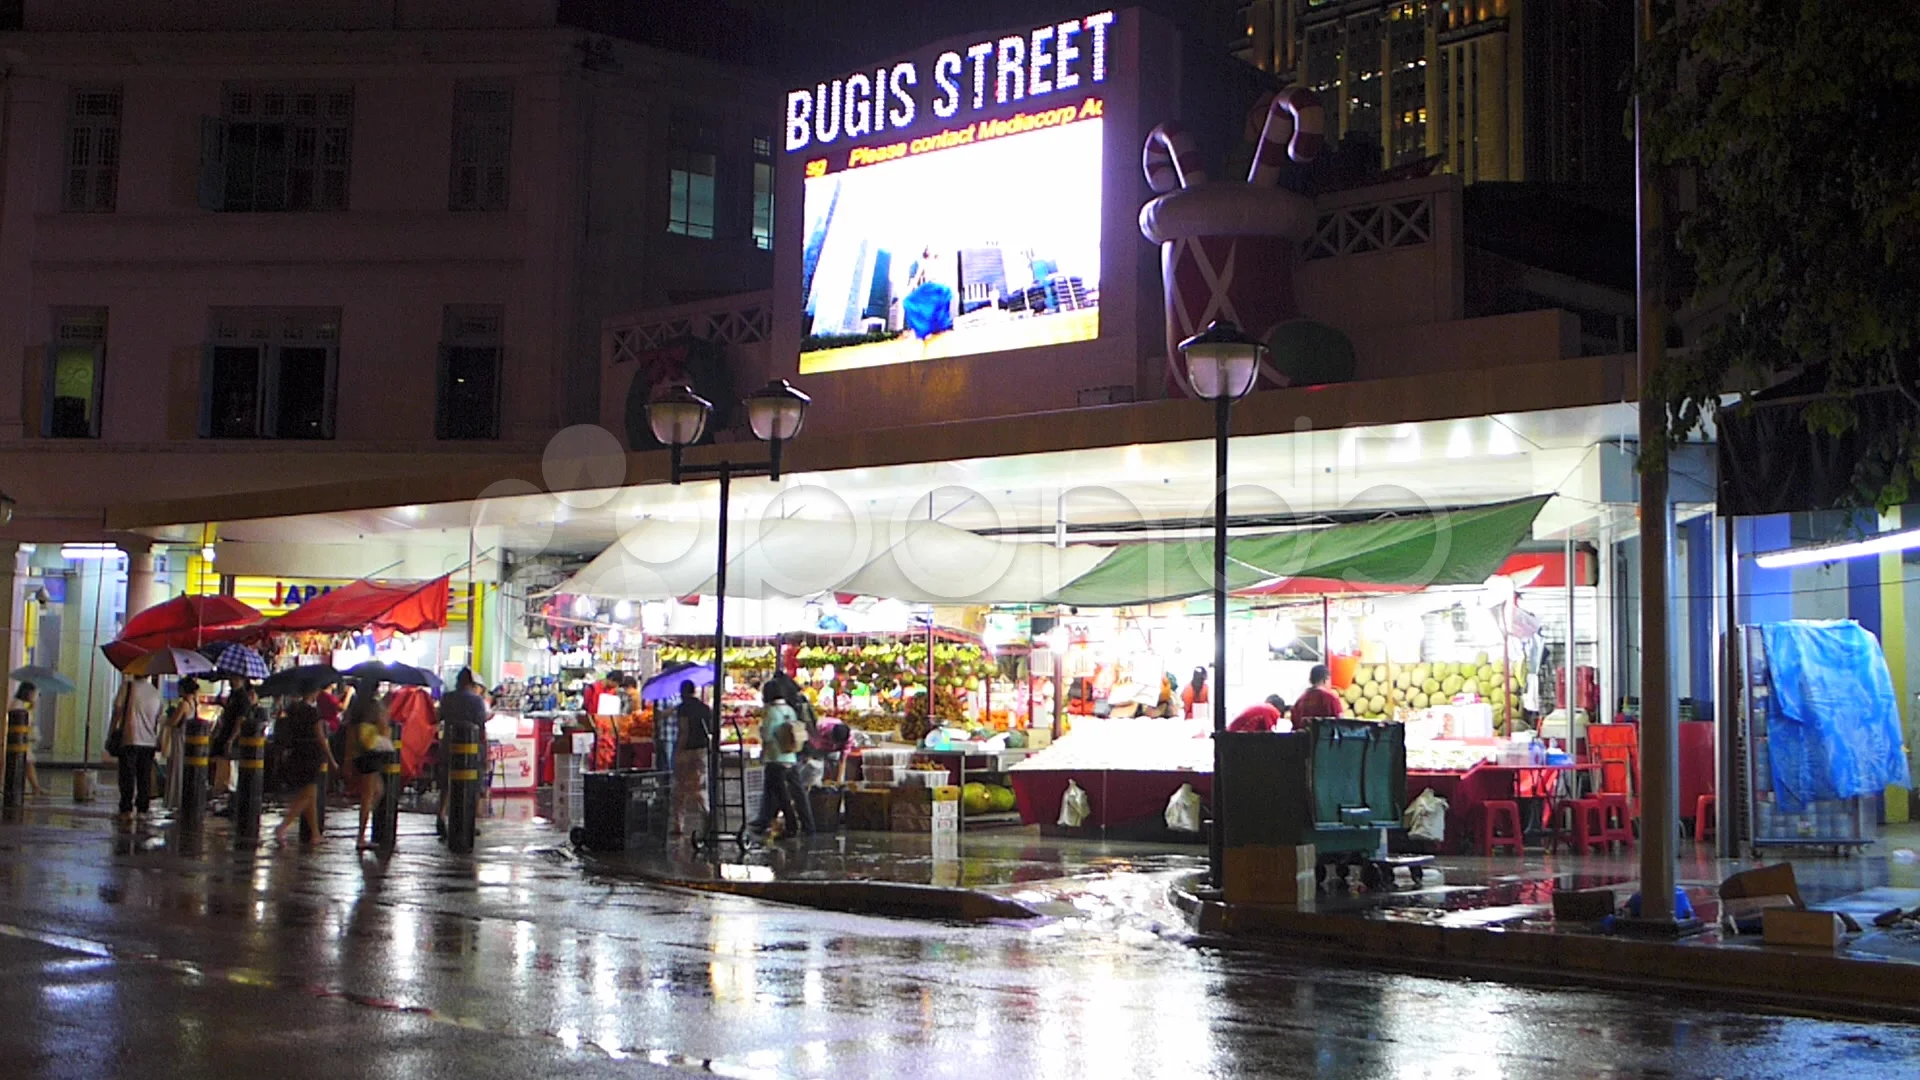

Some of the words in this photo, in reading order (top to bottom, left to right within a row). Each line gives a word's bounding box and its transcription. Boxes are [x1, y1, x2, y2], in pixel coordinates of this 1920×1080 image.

[785, 62, 918, 151] BUGIS
[932, 10, 1116, 118] STREET
[849, 141, 907, 167] Please
[910, 124, 976, 154] contact
[977, 104, 1077, 140] Mediacorp
